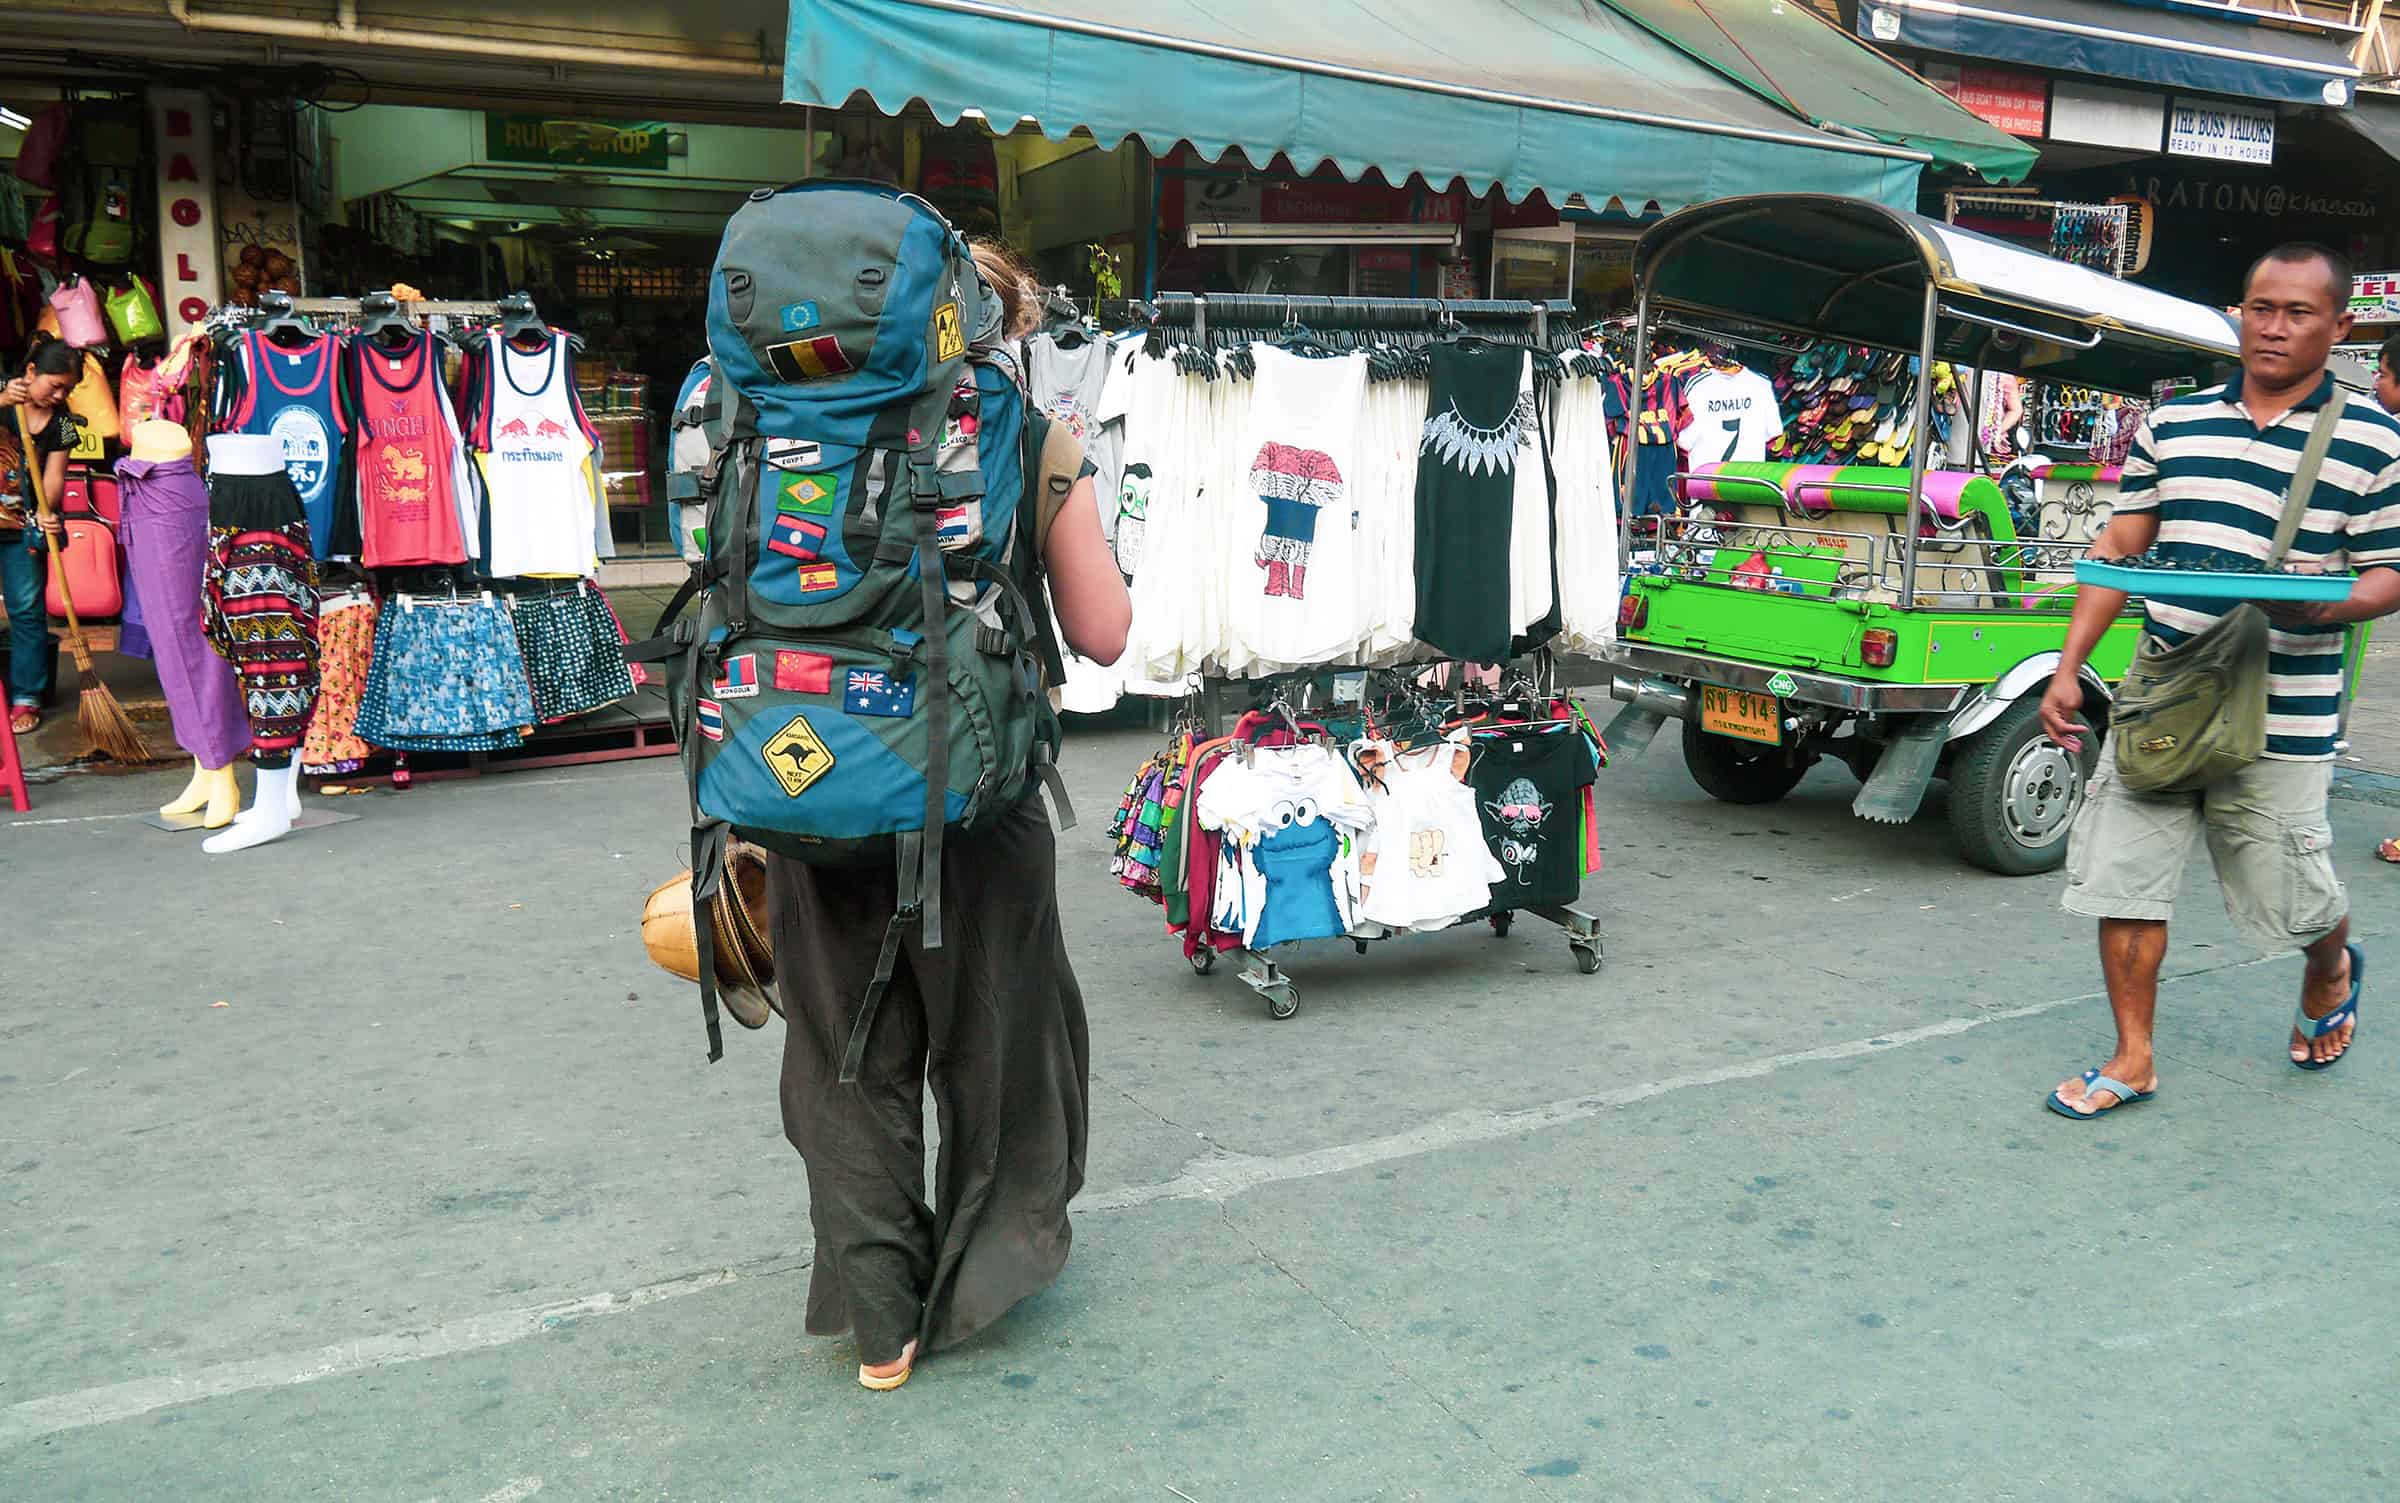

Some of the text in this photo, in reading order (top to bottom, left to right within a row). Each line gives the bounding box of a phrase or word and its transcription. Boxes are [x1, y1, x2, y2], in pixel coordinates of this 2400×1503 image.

[2174, 106, 2273, 144] THE BOSS TAILORS
[2171, 138, 2270, 160] READY IN 12 HOURS
[1721, 417, 1741, 462] 7
[782, 456, 804, 465] EGYPT
[720, 686, 751, 695] MONGOLIA
[1773, 679, 1792, 691] CNG
[1739, 694, 1769, 721] 914
